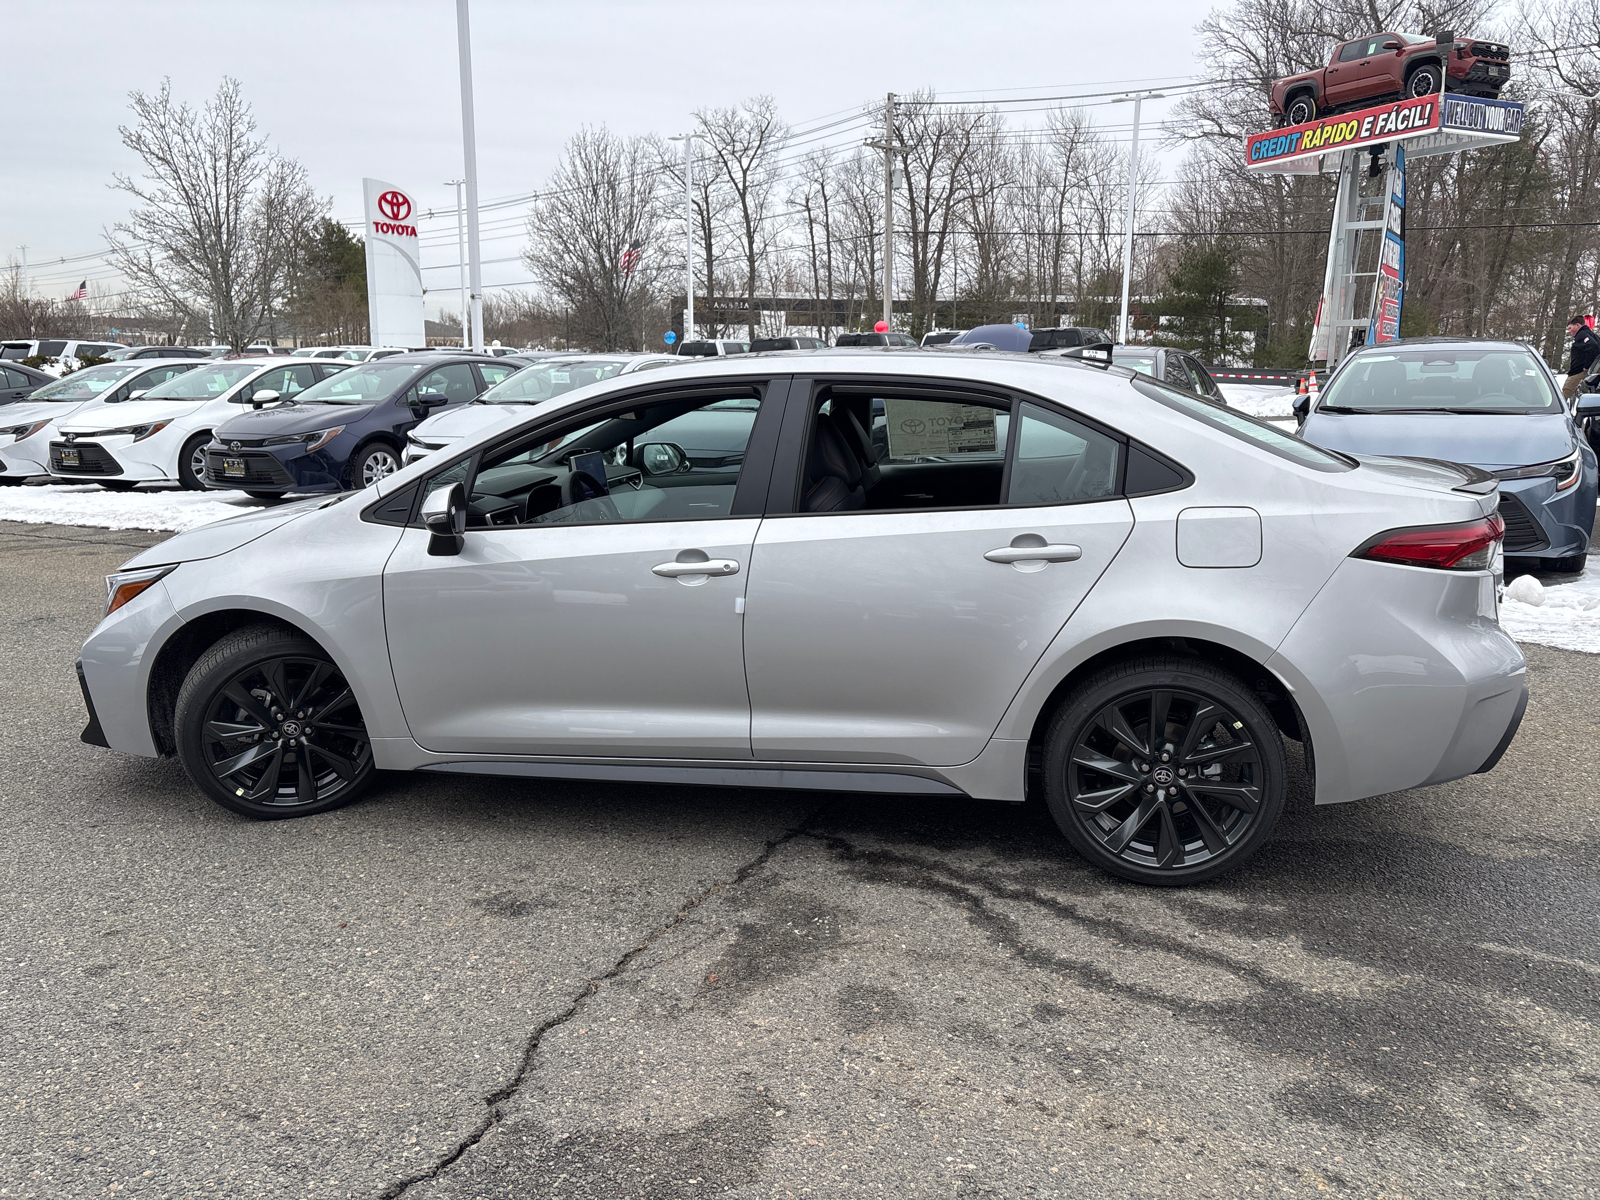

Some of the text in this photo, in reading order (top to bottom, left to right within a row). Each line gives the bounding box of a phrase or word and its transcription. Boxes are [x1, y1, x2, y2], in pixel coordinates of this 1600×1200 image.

[1445, 99, 1521, 133] WE'LL BUY YOUR CAR
[1251, 132, 1302, 161] CREDIT
[1301, 119, 1359, 150] RÁPIDO
[1360, 115, 1376, 138] E
[1374, 102, 1434, 135] FÁCIL!
[373, 221, 418, 237] TOYOTA
[928, 414, 980, 427] TOYOTA
